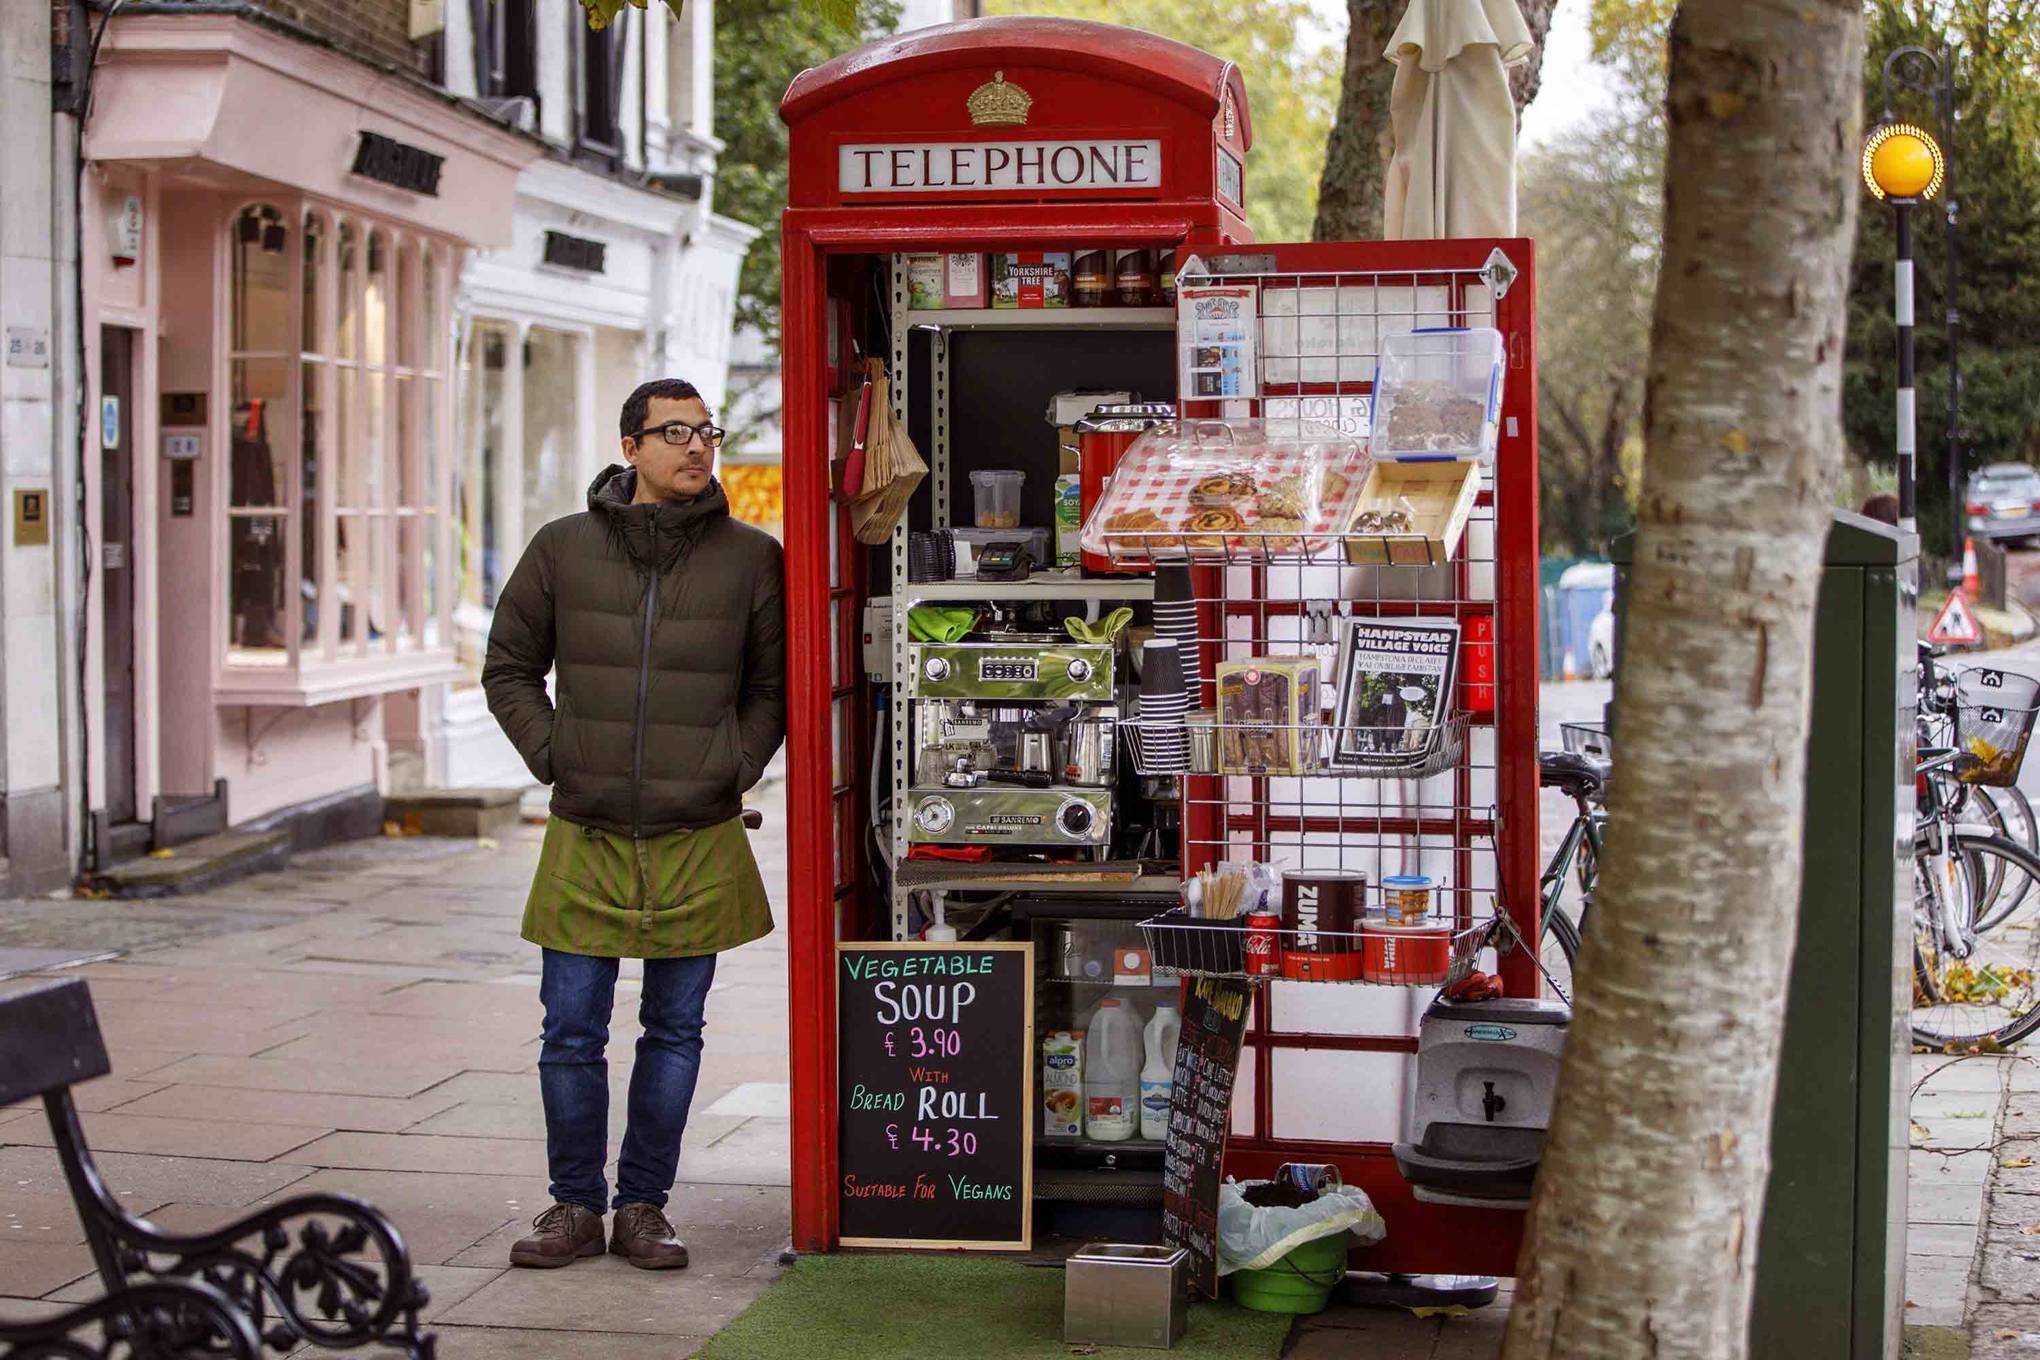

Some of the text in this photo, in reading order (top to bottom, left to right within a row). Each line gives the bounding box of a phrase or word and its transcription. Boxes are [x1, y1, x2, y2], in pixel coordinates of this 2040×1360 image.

[853, 144, 1149, 187] TELEPHONE
[1008, 265, 1054, 277] YORKSHIRE
[1021, 276, 1041, 285] TREE
[1063, 499, 1080, 507] SOY
[1357, 627, 1451, 643] HAMPSTEAD
[1357, 638, 1449, 654] VILLAGE VOICE
[1001, 815, 1039, 824] SANREMO
[1297, 885, 1319, 946] ZUMA
[845, 955, 994, 980] VEGETABLE
[874, 981, 976, 1025] SOUP
[910, 1026, 961, 1058] 3.90
[1049, 1055, 1074, 1066] alpro
[909, 1067, 949, 1084] WITH
[850, 1084, 999, 1121] BREAD ROLL
[911, 1126, 977, 1157] 4.30
[844, 1173, 1013, 1201] SUITABLE FOR VEGANS
